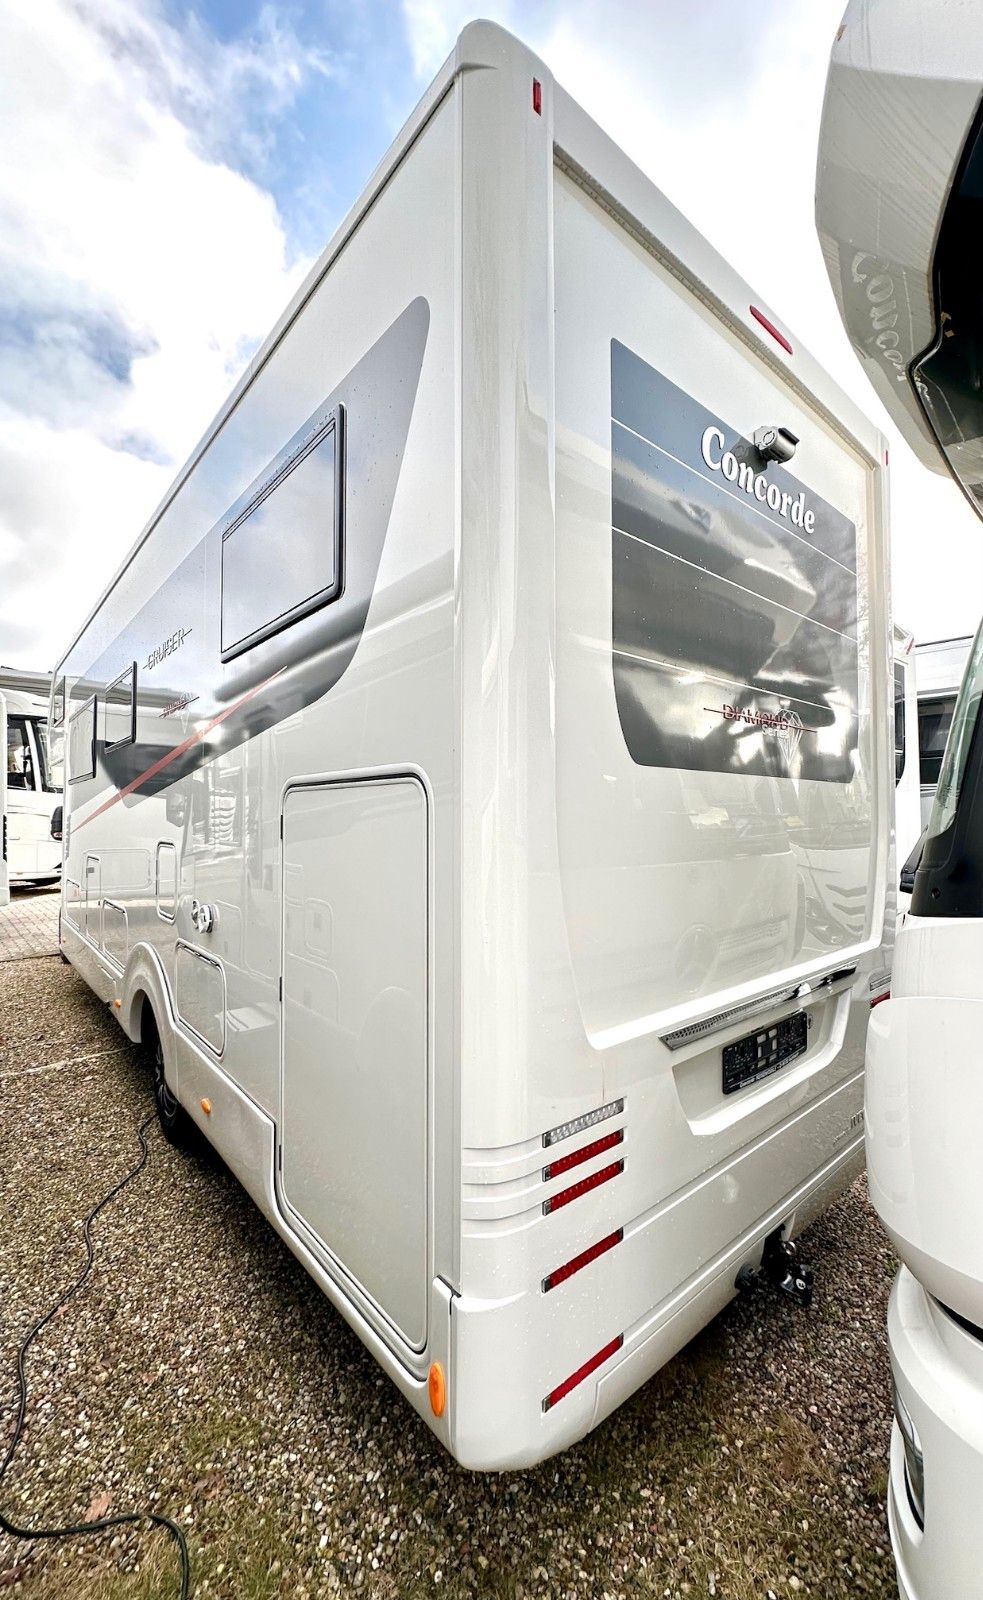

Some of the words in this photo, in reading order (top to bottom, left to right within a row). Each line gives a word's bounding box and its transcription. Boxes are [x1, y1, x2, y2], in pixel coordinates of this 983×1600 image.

[701, 426, 816, 534] Concorde
[147, 628, 185, 670] CRUISER
[722, 704, 790, 731] DIAMOND
